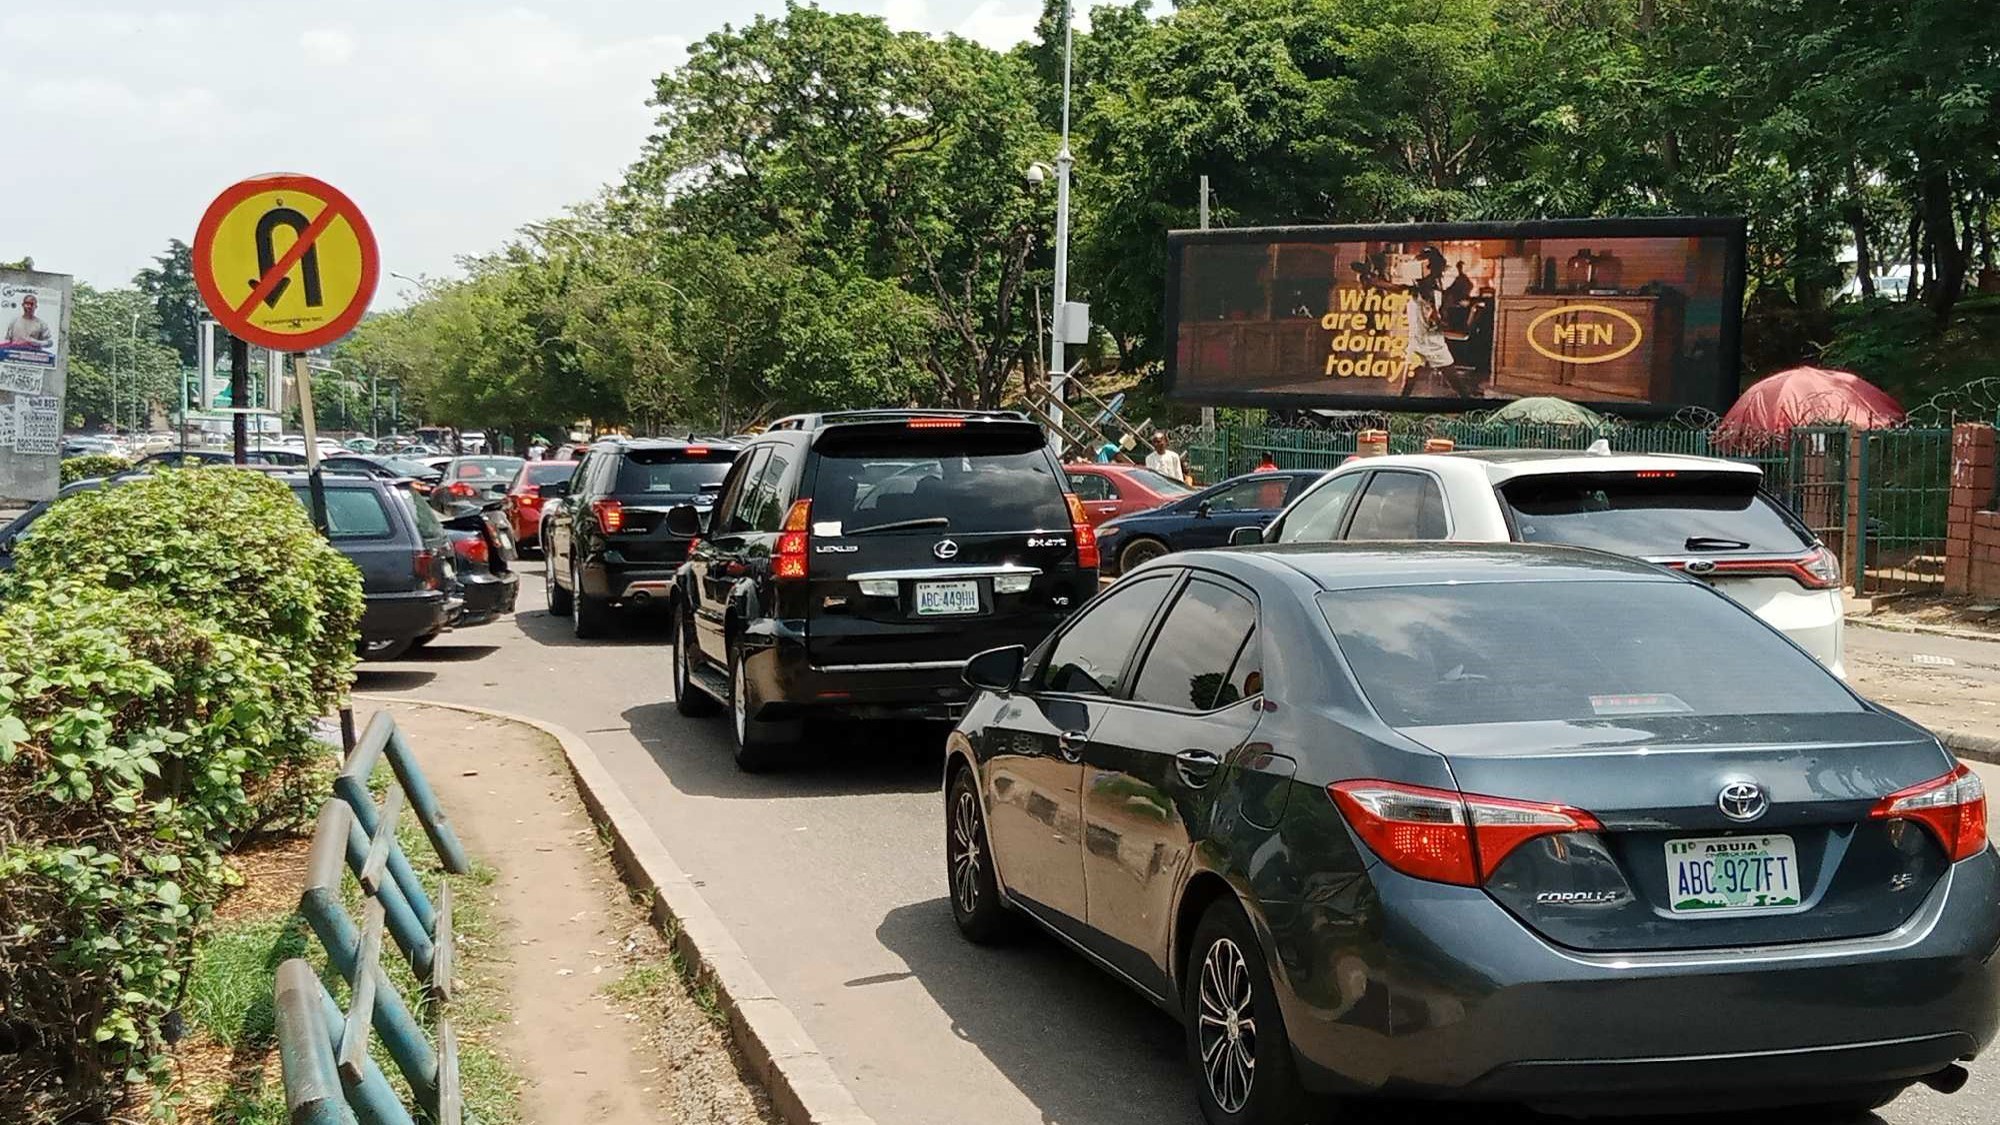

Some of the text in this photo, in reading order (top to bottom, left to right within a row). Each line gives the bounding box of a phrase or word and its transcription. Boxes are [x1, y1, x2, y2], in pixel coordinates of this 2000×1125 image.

[1339, 287, 1412, 312] What
[1321, 313, 1368, 330] are
[1331, 329, 1409, 358] doing
[1553, 323, 1614, 346] MTN
[1325, 353, 1425, 383] today?
[816, 545, 858, 553] LEXUS
[921, 590, 976, 607] ABC-449HH
[1705, 842, 1758, 852] ABUJA
[1678, 857, 1788, 895] ABC-927FT
[1536, 891, 1617, 904] COROLLA
